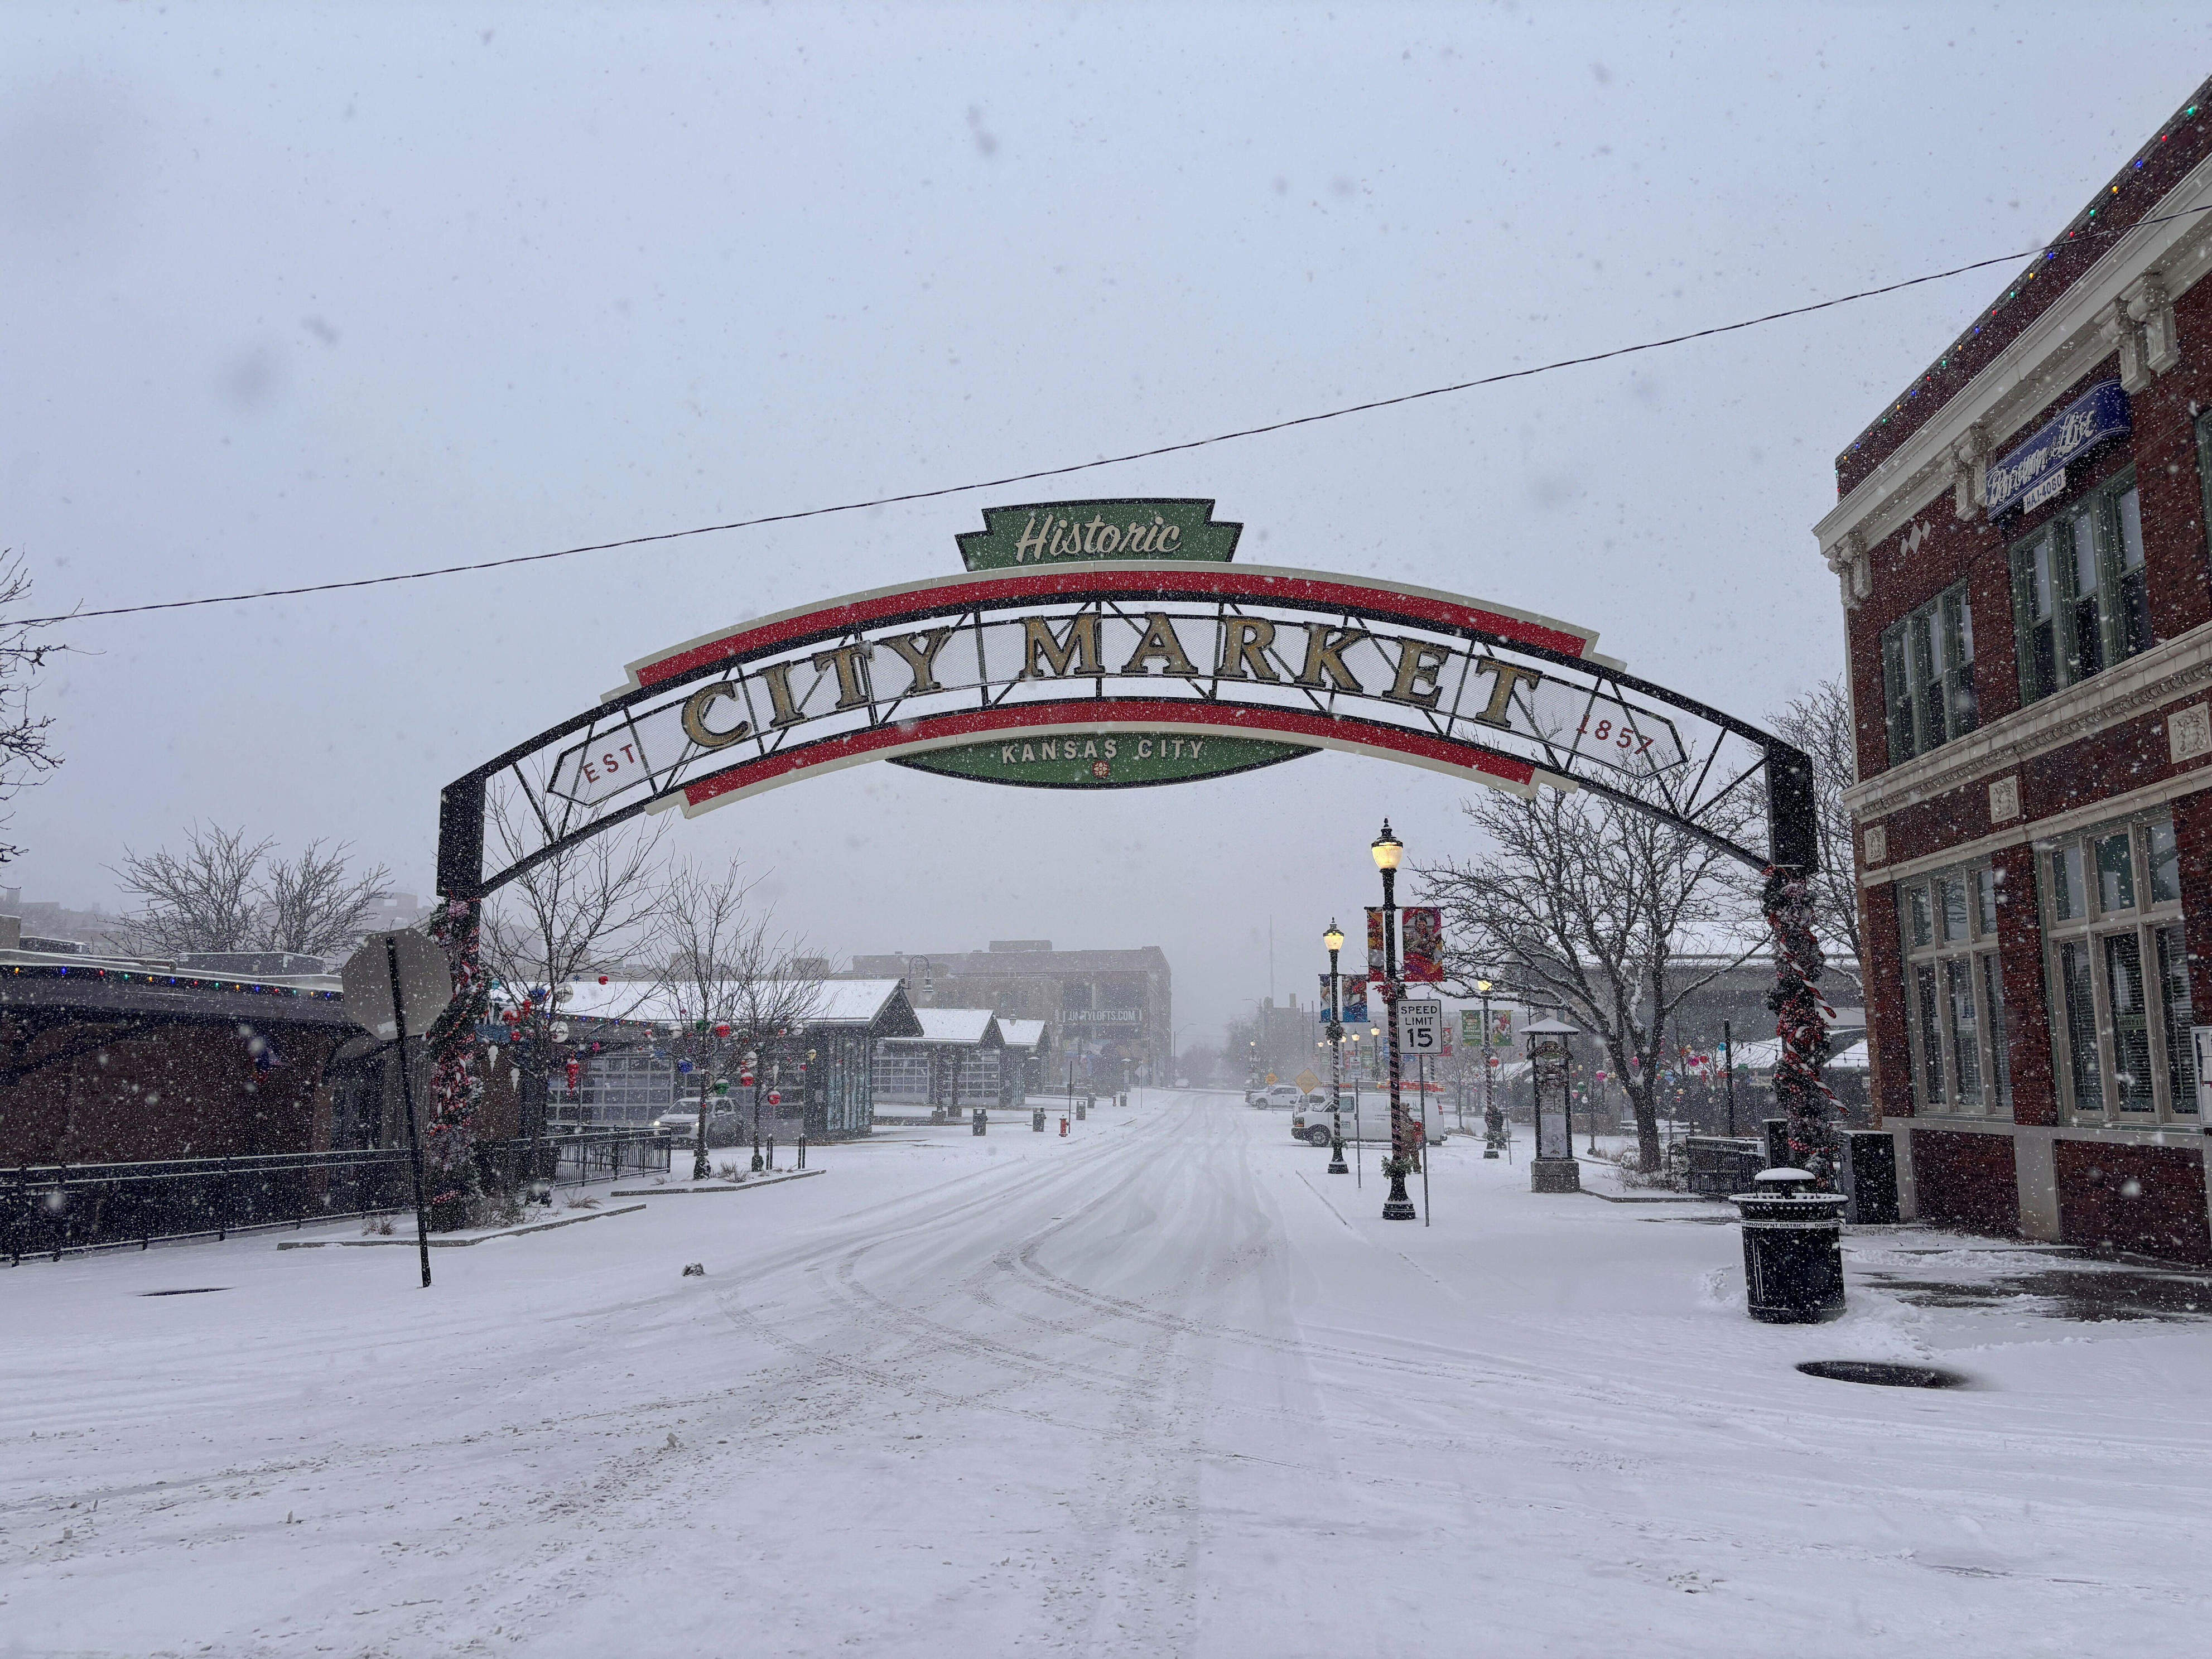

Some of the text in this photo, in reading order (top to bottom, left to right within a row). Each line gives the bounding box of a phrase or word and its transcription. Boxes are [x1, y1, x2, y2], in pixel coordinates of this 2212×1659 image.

[1015, 513, 1182, 563] Historic
[681, 610, 1543, 749] CITY MARKET
[1577, 713, 1654, 755] 1857
[1002, 739, 1204, 764] KANSAS CITY
[1401, 1006, 1437, 1014] SPEED
[1405, 1017, 1433, 1025] LIMIT
[1407, 1028, 1433, 1048] 15
